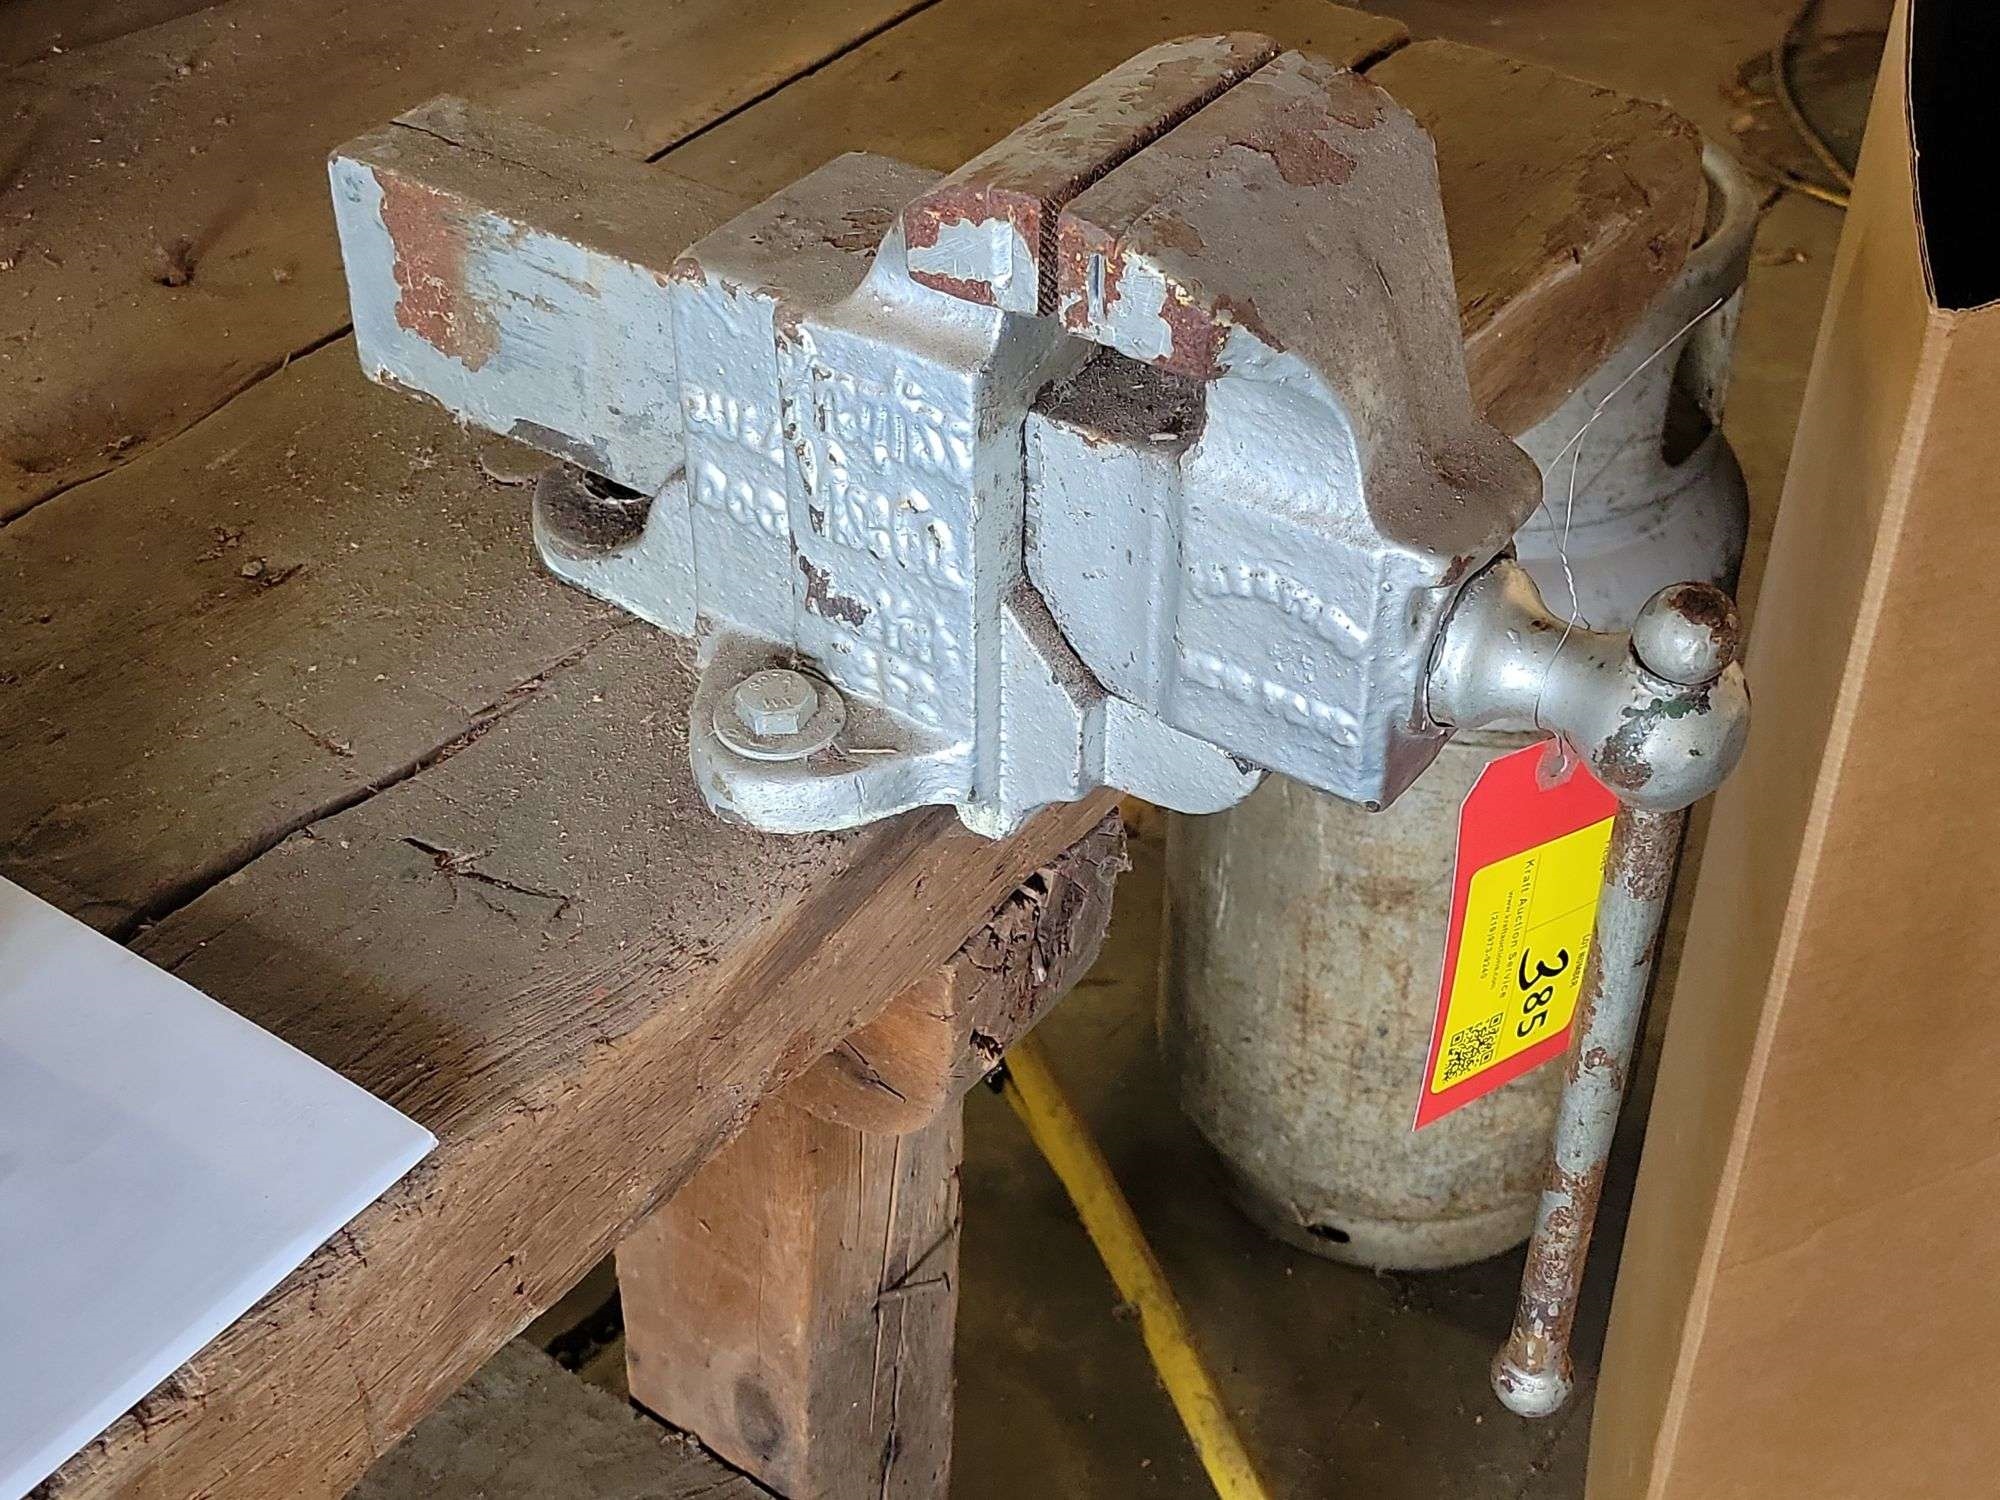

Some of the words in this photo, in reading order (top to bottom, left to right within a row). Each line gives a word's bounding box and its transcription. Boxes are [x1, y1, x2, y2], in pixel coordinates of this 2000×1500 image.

[1520, 858, 1535, 898] Kraft
[1511, 897, 1528, 949] Auction
[1499, 951, 1518, 998] Service
[1517, 947, 1569, 1037] 385
